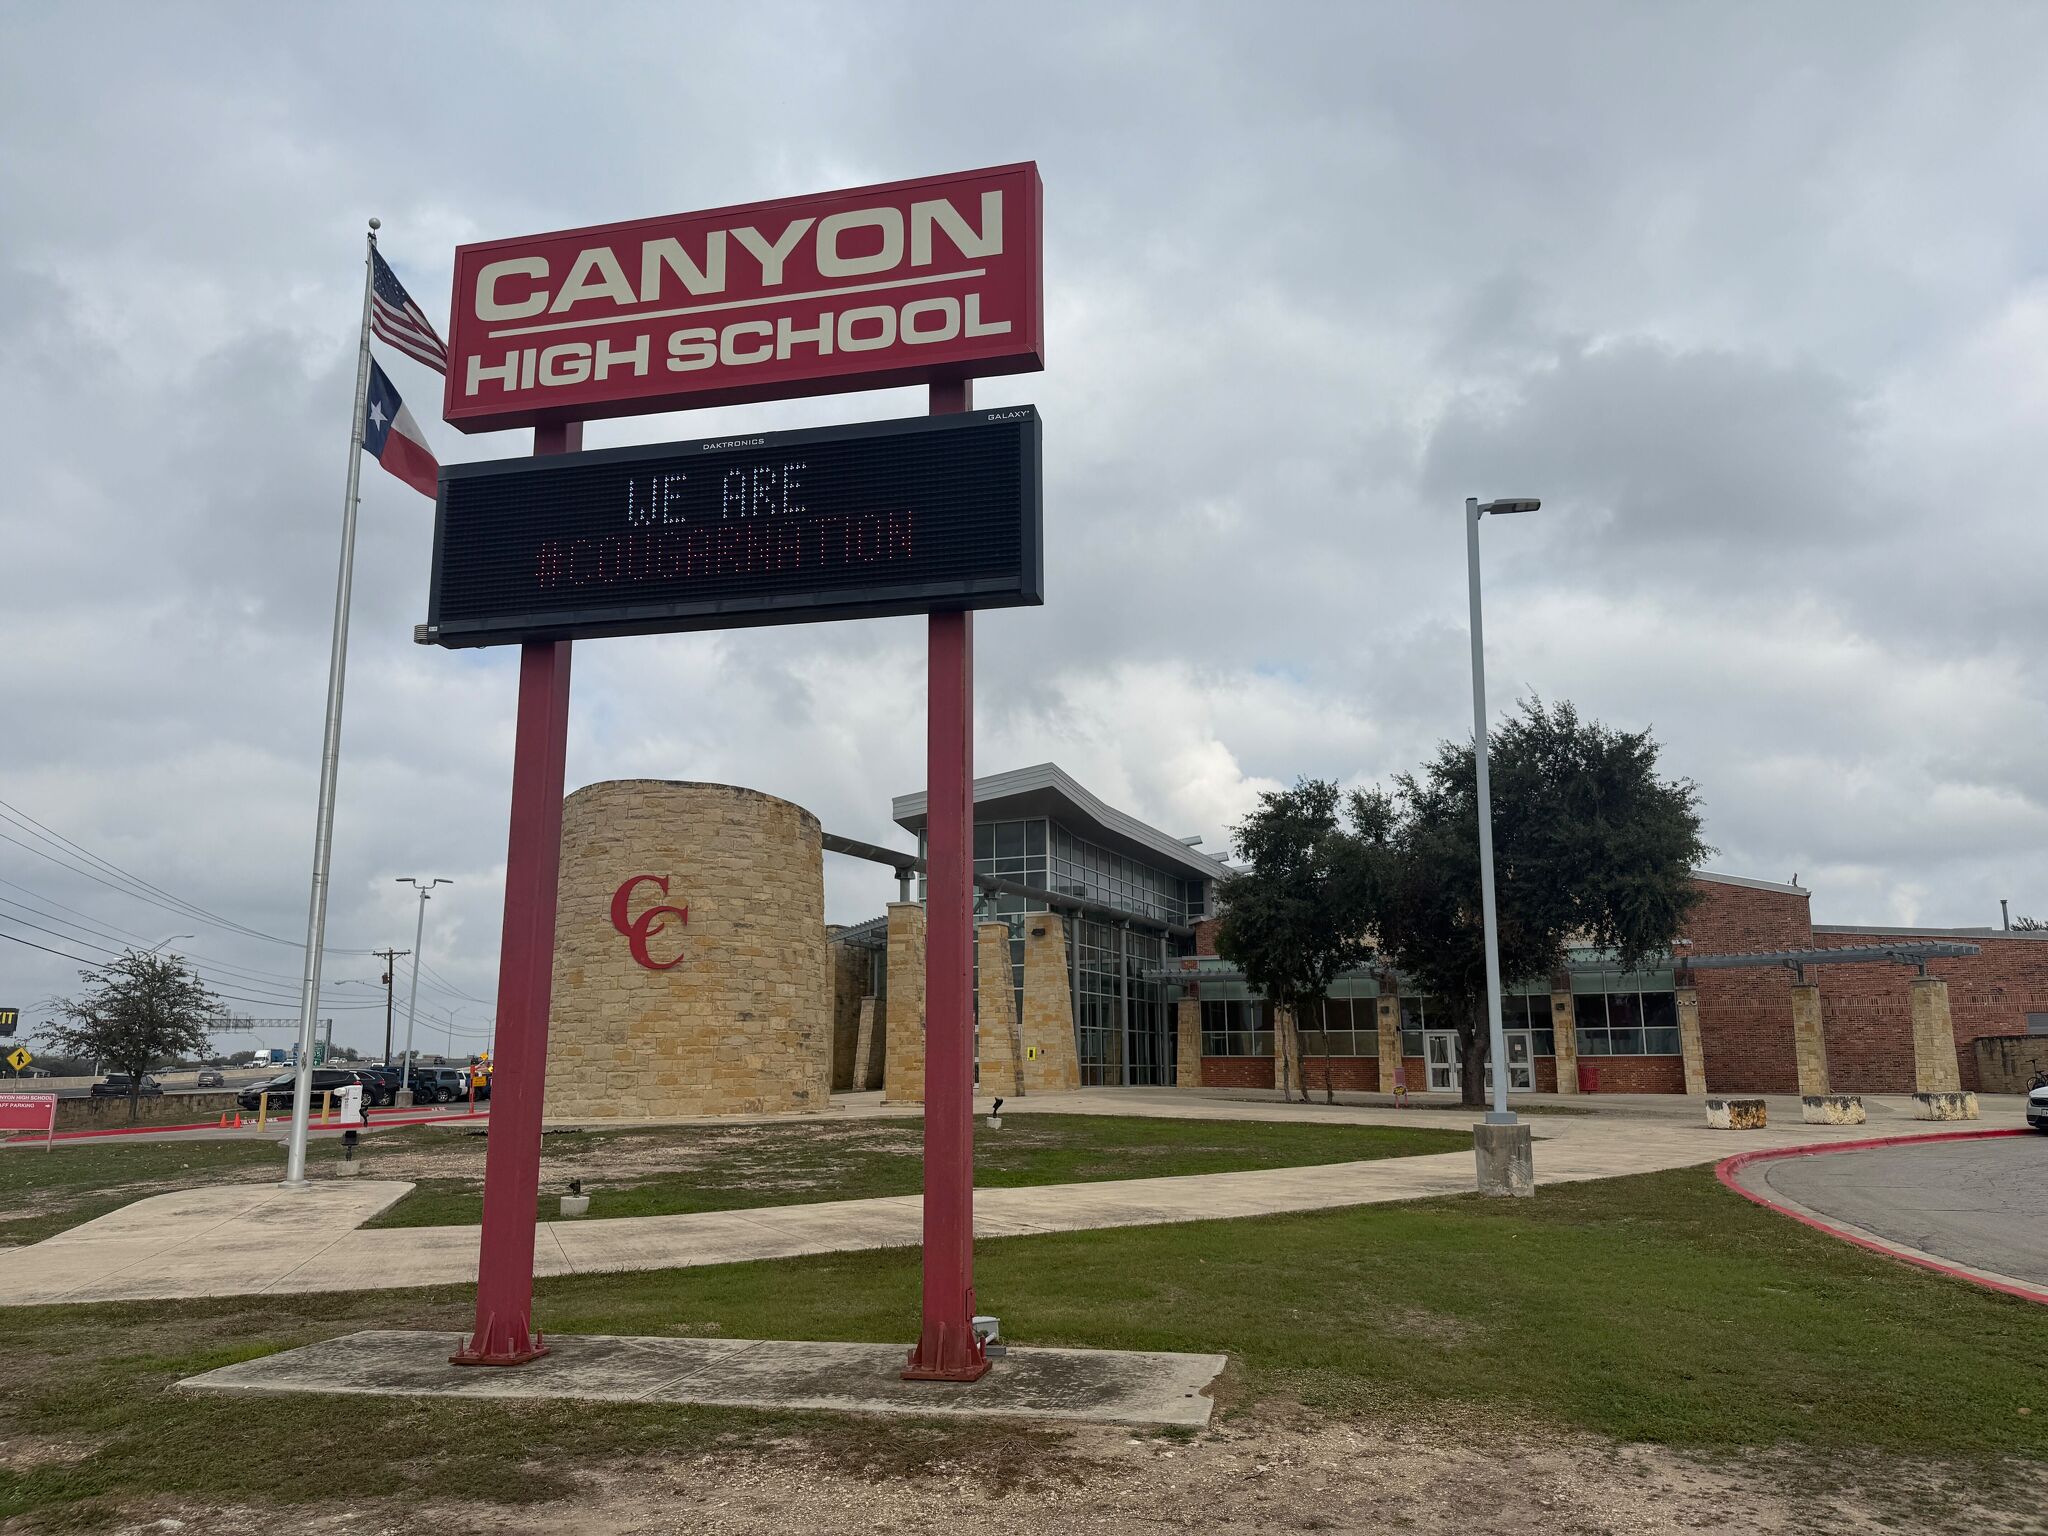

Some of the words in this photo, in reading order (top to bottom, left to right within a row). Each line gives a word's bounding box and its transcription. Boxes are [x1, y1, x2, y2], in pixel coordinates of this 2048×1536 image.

[474, 190, 1004, 322] CANYON
[465, 335, 650, 396] HIGH
[666, 293, 1012, 372] SCHOOL
[702, 438, 765, 450] DAKTRONICS
[629, 474, 687, 526] WE
[723, 462, 807, 519] ARE
[535, 510, 912, 588] #COUGARNATION
